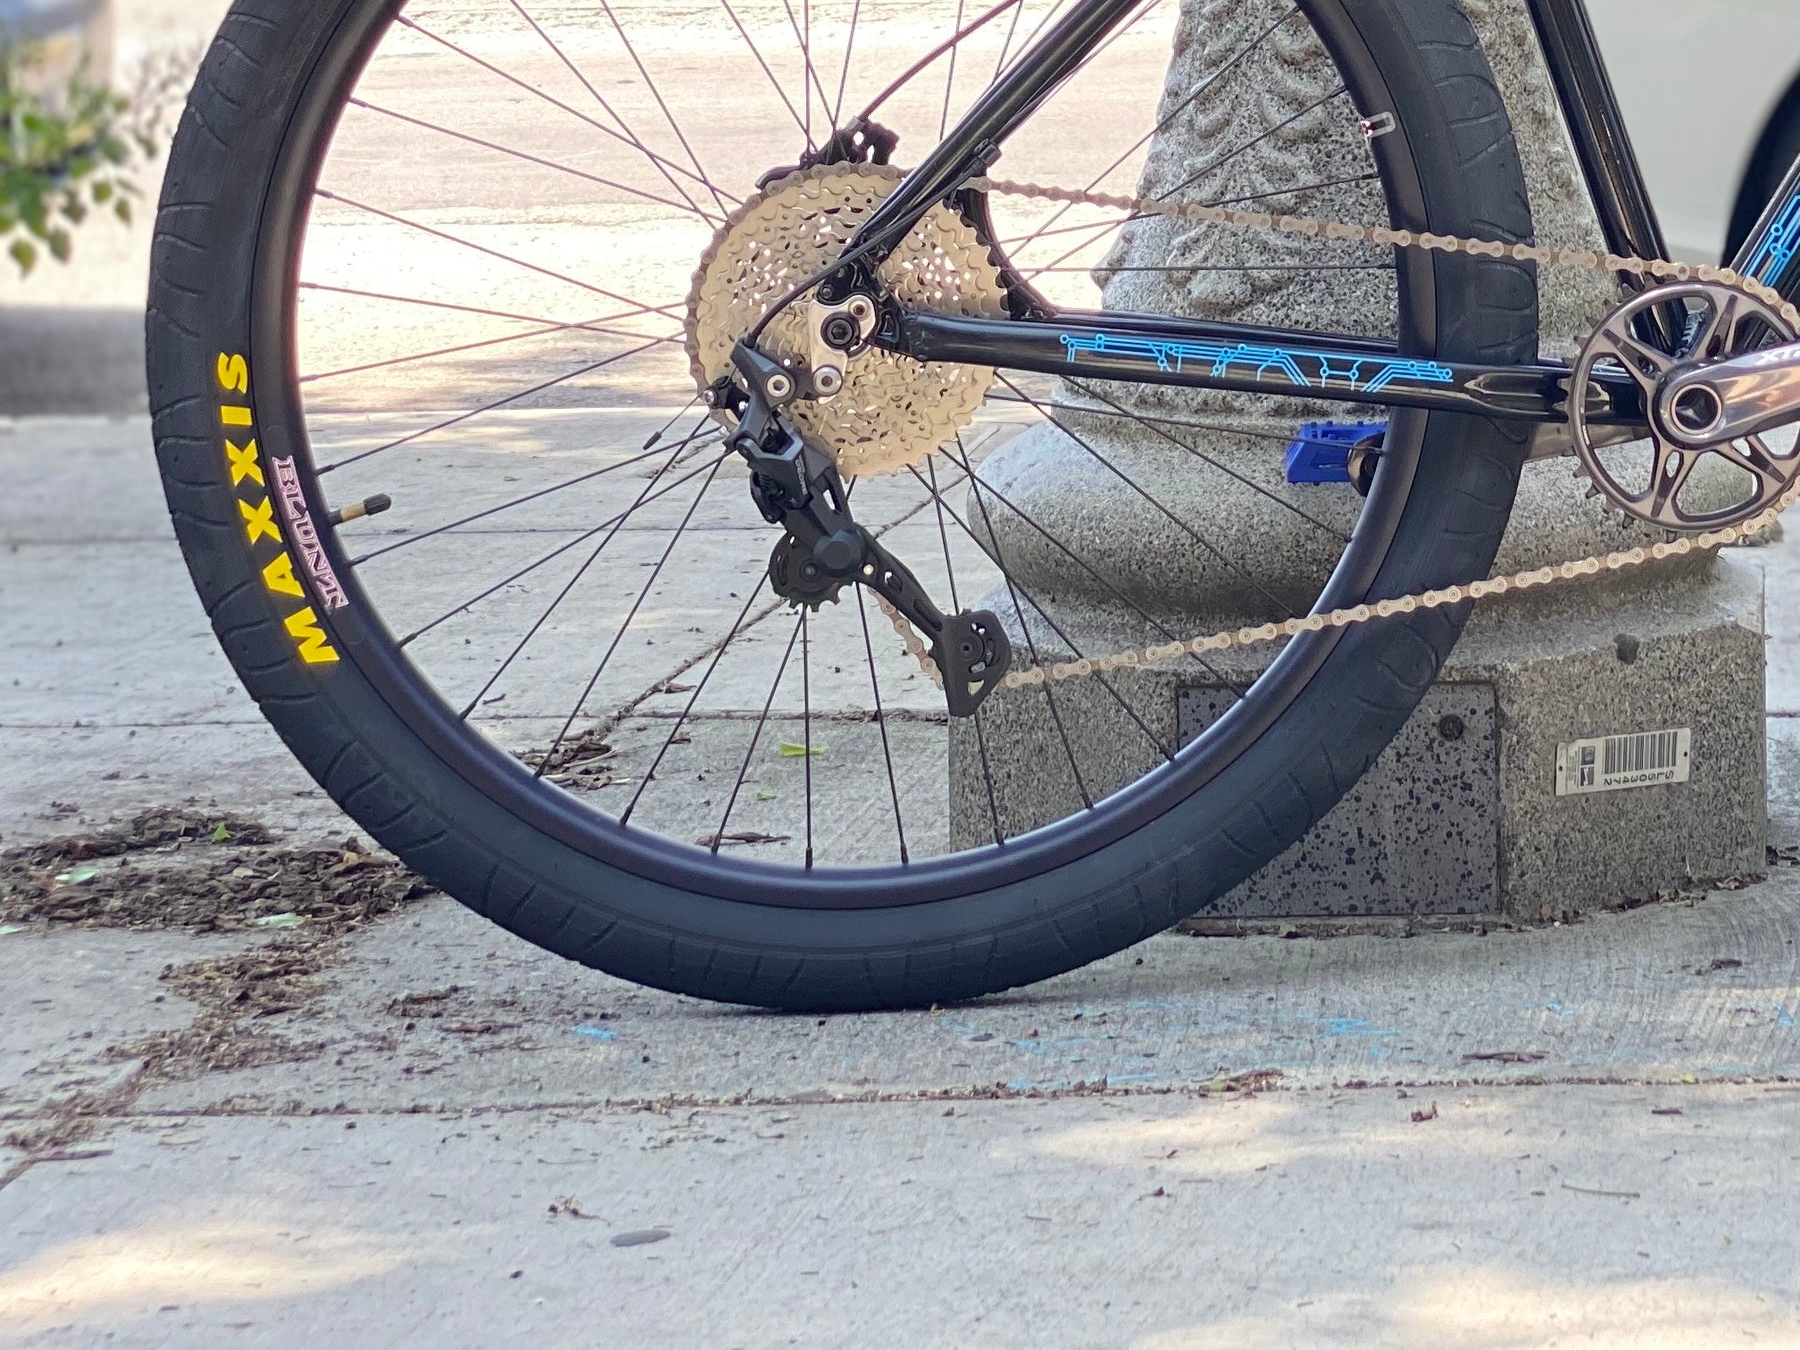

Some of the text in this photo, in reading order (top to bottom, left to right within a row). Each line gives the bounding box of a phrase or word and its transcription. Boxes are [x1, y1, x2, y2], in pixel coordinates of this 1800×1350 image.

[217, 351, 341, 664] MAXXIS
[271, 455, 349, 610] BLUNT
[1604, 770, 1674, 786] SL503472
